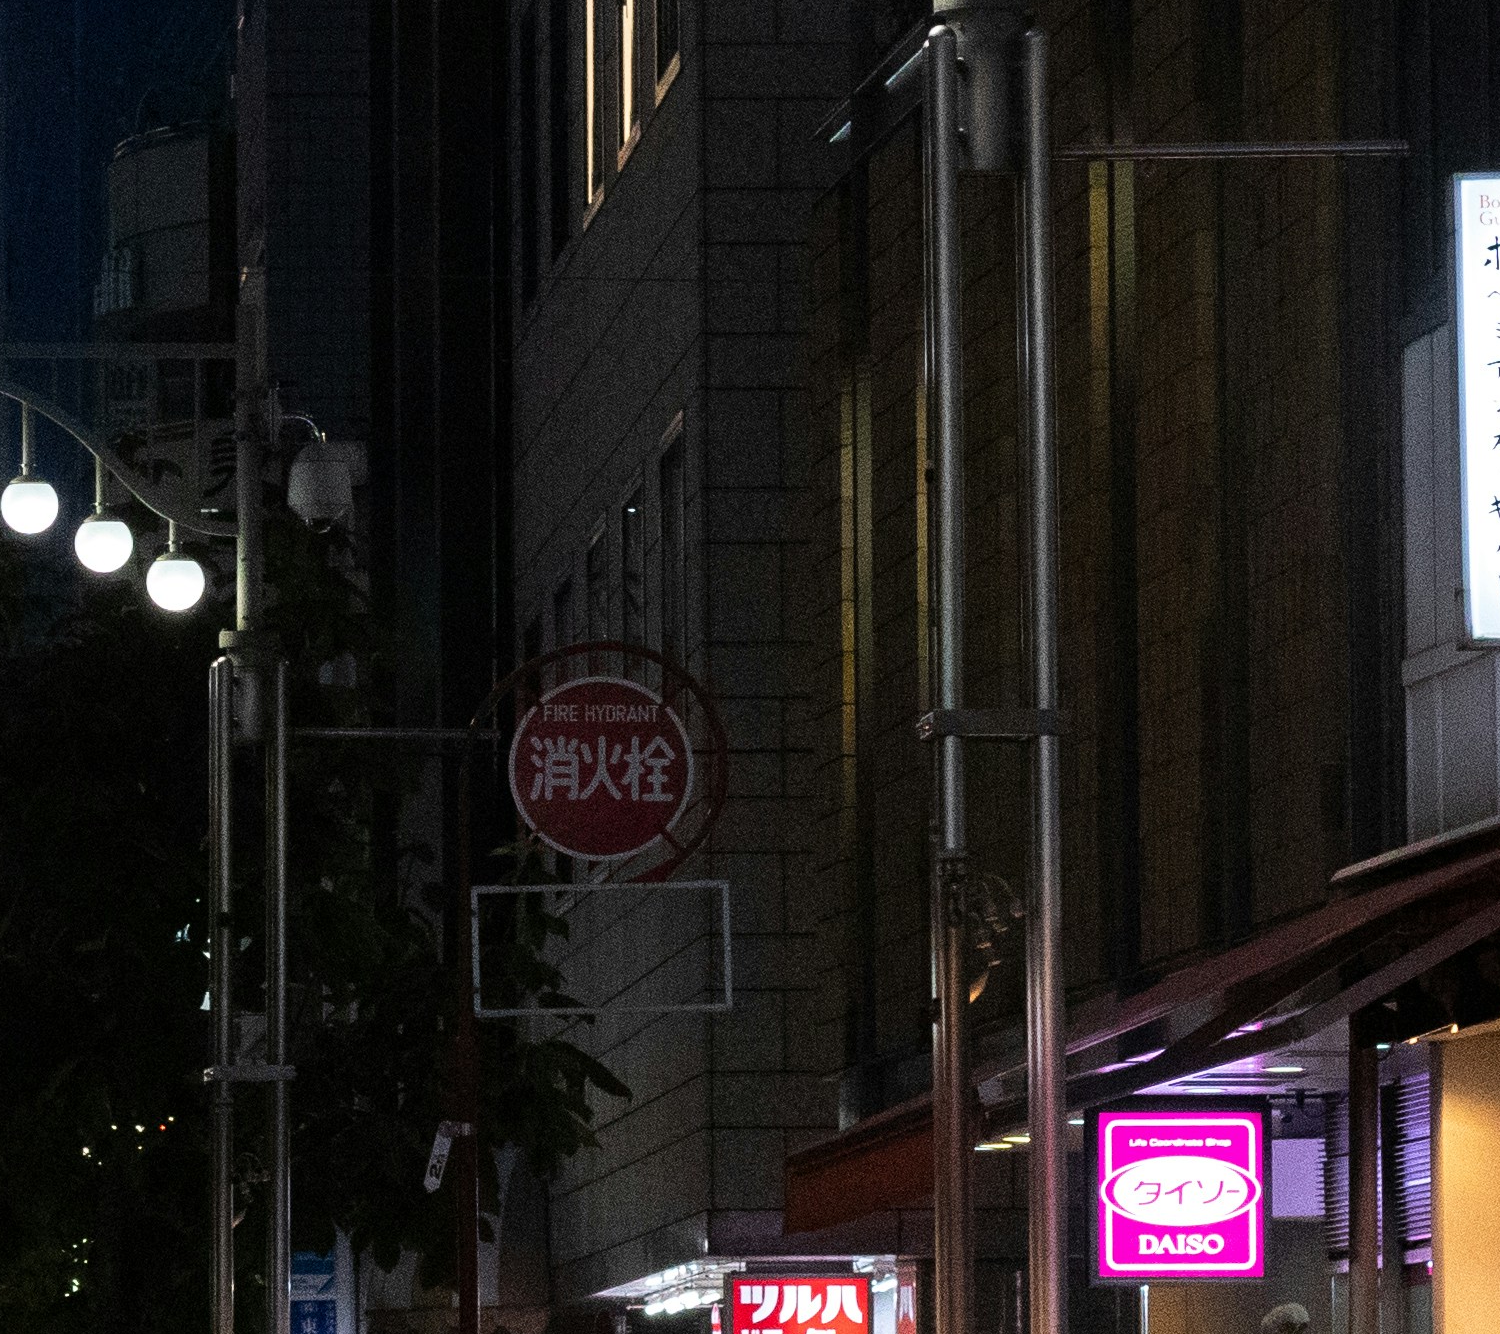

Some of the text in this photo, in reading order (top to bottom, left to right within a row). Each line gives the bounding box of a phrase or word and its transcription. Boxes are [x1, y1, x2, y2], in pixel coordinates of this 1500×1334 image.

[542, 704, 660, 723] FIRE HYDRANT
[529, 734, 677, 803] 消火栓
[1138, 1233, 1225, 1255] DAISO
[739, 1285, 864, 1324] ツルハ
